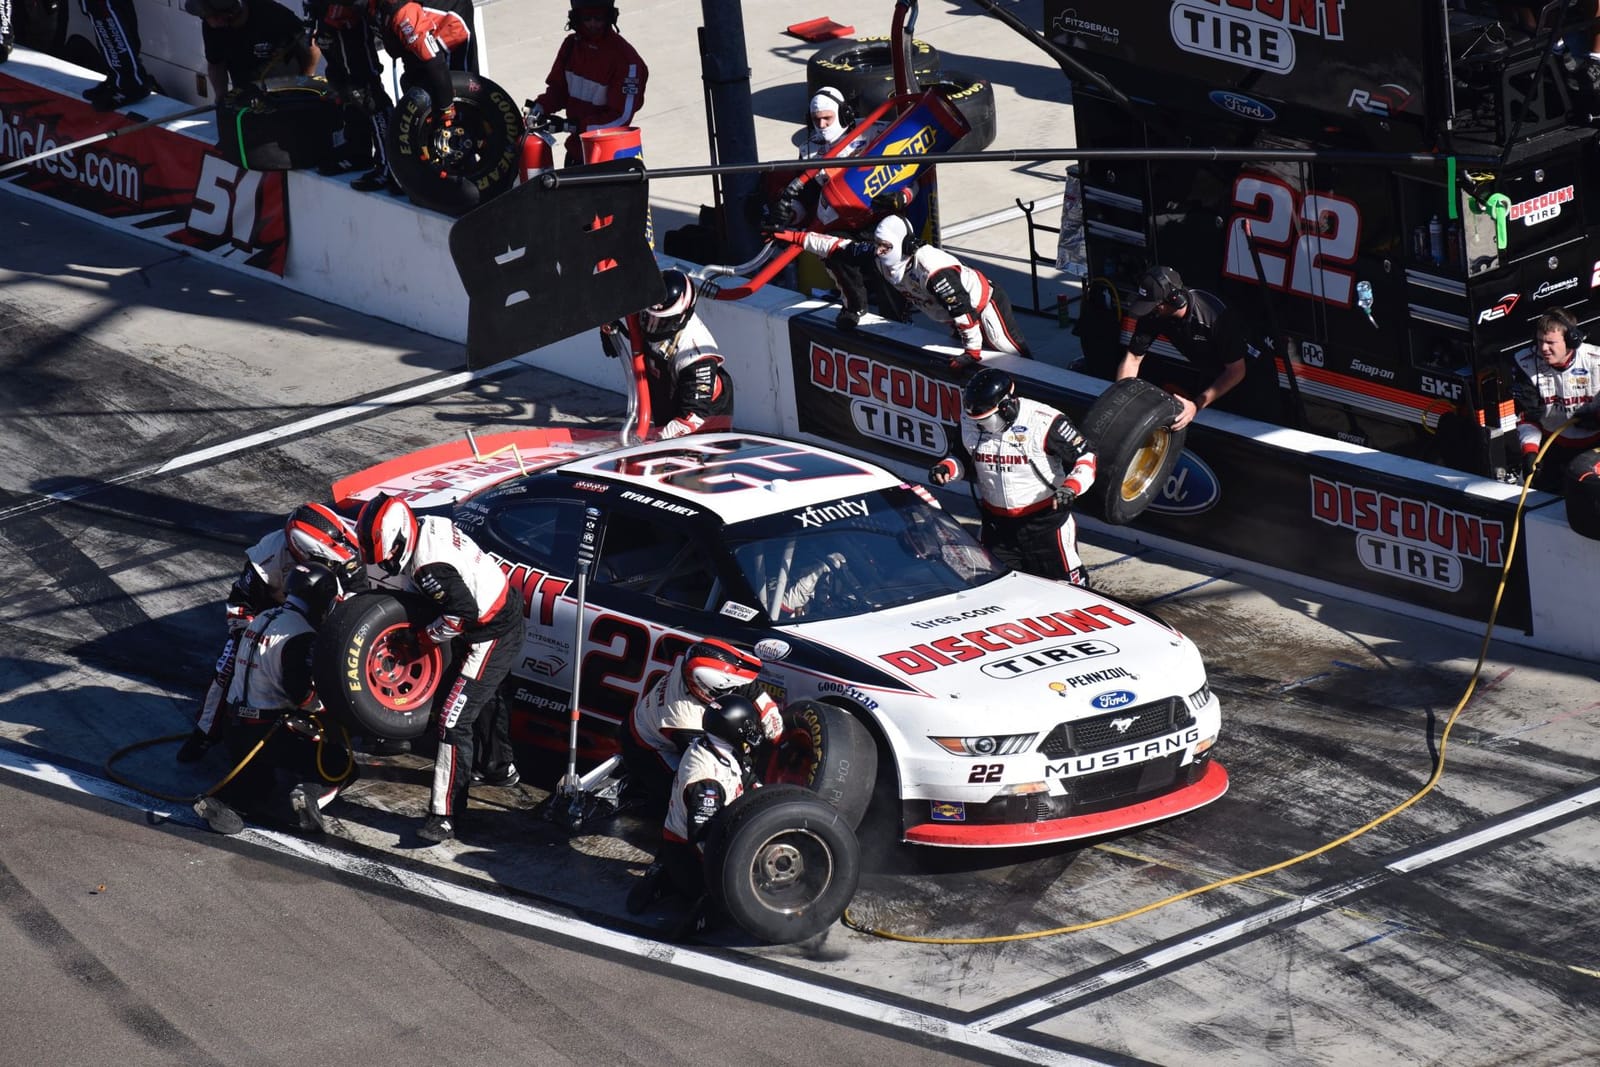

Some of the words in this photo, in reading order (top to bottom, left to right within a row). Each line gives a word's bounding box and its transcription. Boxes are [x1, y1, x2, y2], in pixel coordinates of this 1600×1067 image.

[1064, 17, 1120, 37] FITZGERALD
[1184, 10, 1279, 63] TIRE
[1222, 93, 1265, 119] Ford
[399, 101, 418, 155] EAGLE
[1510, 185, 1574, 220] DISCOUNT
[1529, 206, 1557, 223] TIRE
[1222, 170, 1361, 309] 22
[1303, 345, 1324, 364] PPG
[1350, 358, 1395, 380] Snap-on
[810, 341, 965, 426] DISCOUN
[1420, 375, 1463, 400] SKF
[860, 404, 936, 449] TIRE
[620, 490, 655, 505] RYAN
[650, 499, 700, 517] BLANEY
[793, 499, 870, 528] xfinity
[1310, 474, 1504, 567] DISCOUNT
[1367, 538, 1451, 584] TIRE
[911, 603, 1006, 631] tires.com
[877, 604, 1136, 676] DISCOUNT
[347, 633, 365, 692] EAGLE
[992, 642, 1107, 675] TIRE
[1065, 666, 1132, 689] PENNZOIL
[448, 698, 465, 724] TIRE
[514, 686, 567, 714] Snap-on
[1099, 692, 1129, 708] Ford
[1044, 728, 1199, 778] MUSTANG
[967, 763, 1005, 784] 22
